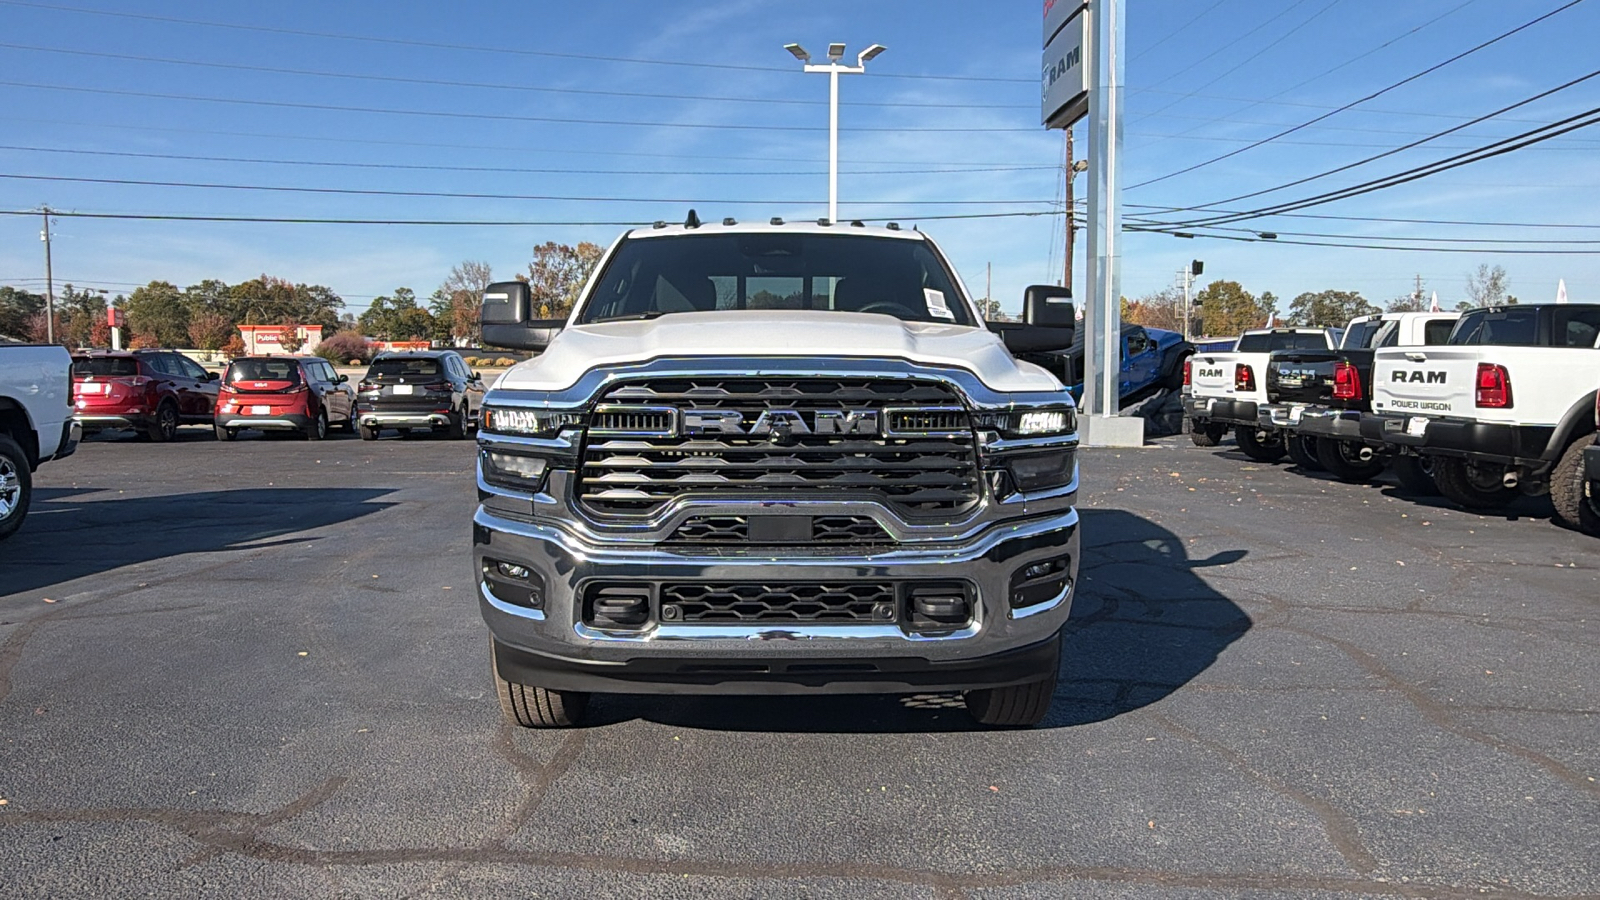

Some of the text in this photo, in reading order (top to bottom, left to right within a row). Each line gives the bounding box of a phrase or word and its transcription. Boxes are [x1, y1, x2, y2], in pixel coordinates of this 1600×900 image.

[1049, 45, 1080, 86] RAM
[257, 334, 278, 342] Public
[1199, 369, 1223, 377] RAM
[1390, 370, 1447, 384] RAM
[1391, 400, 1452, 411] POWER WAGON
[682, 409, 881, 435] RAM
